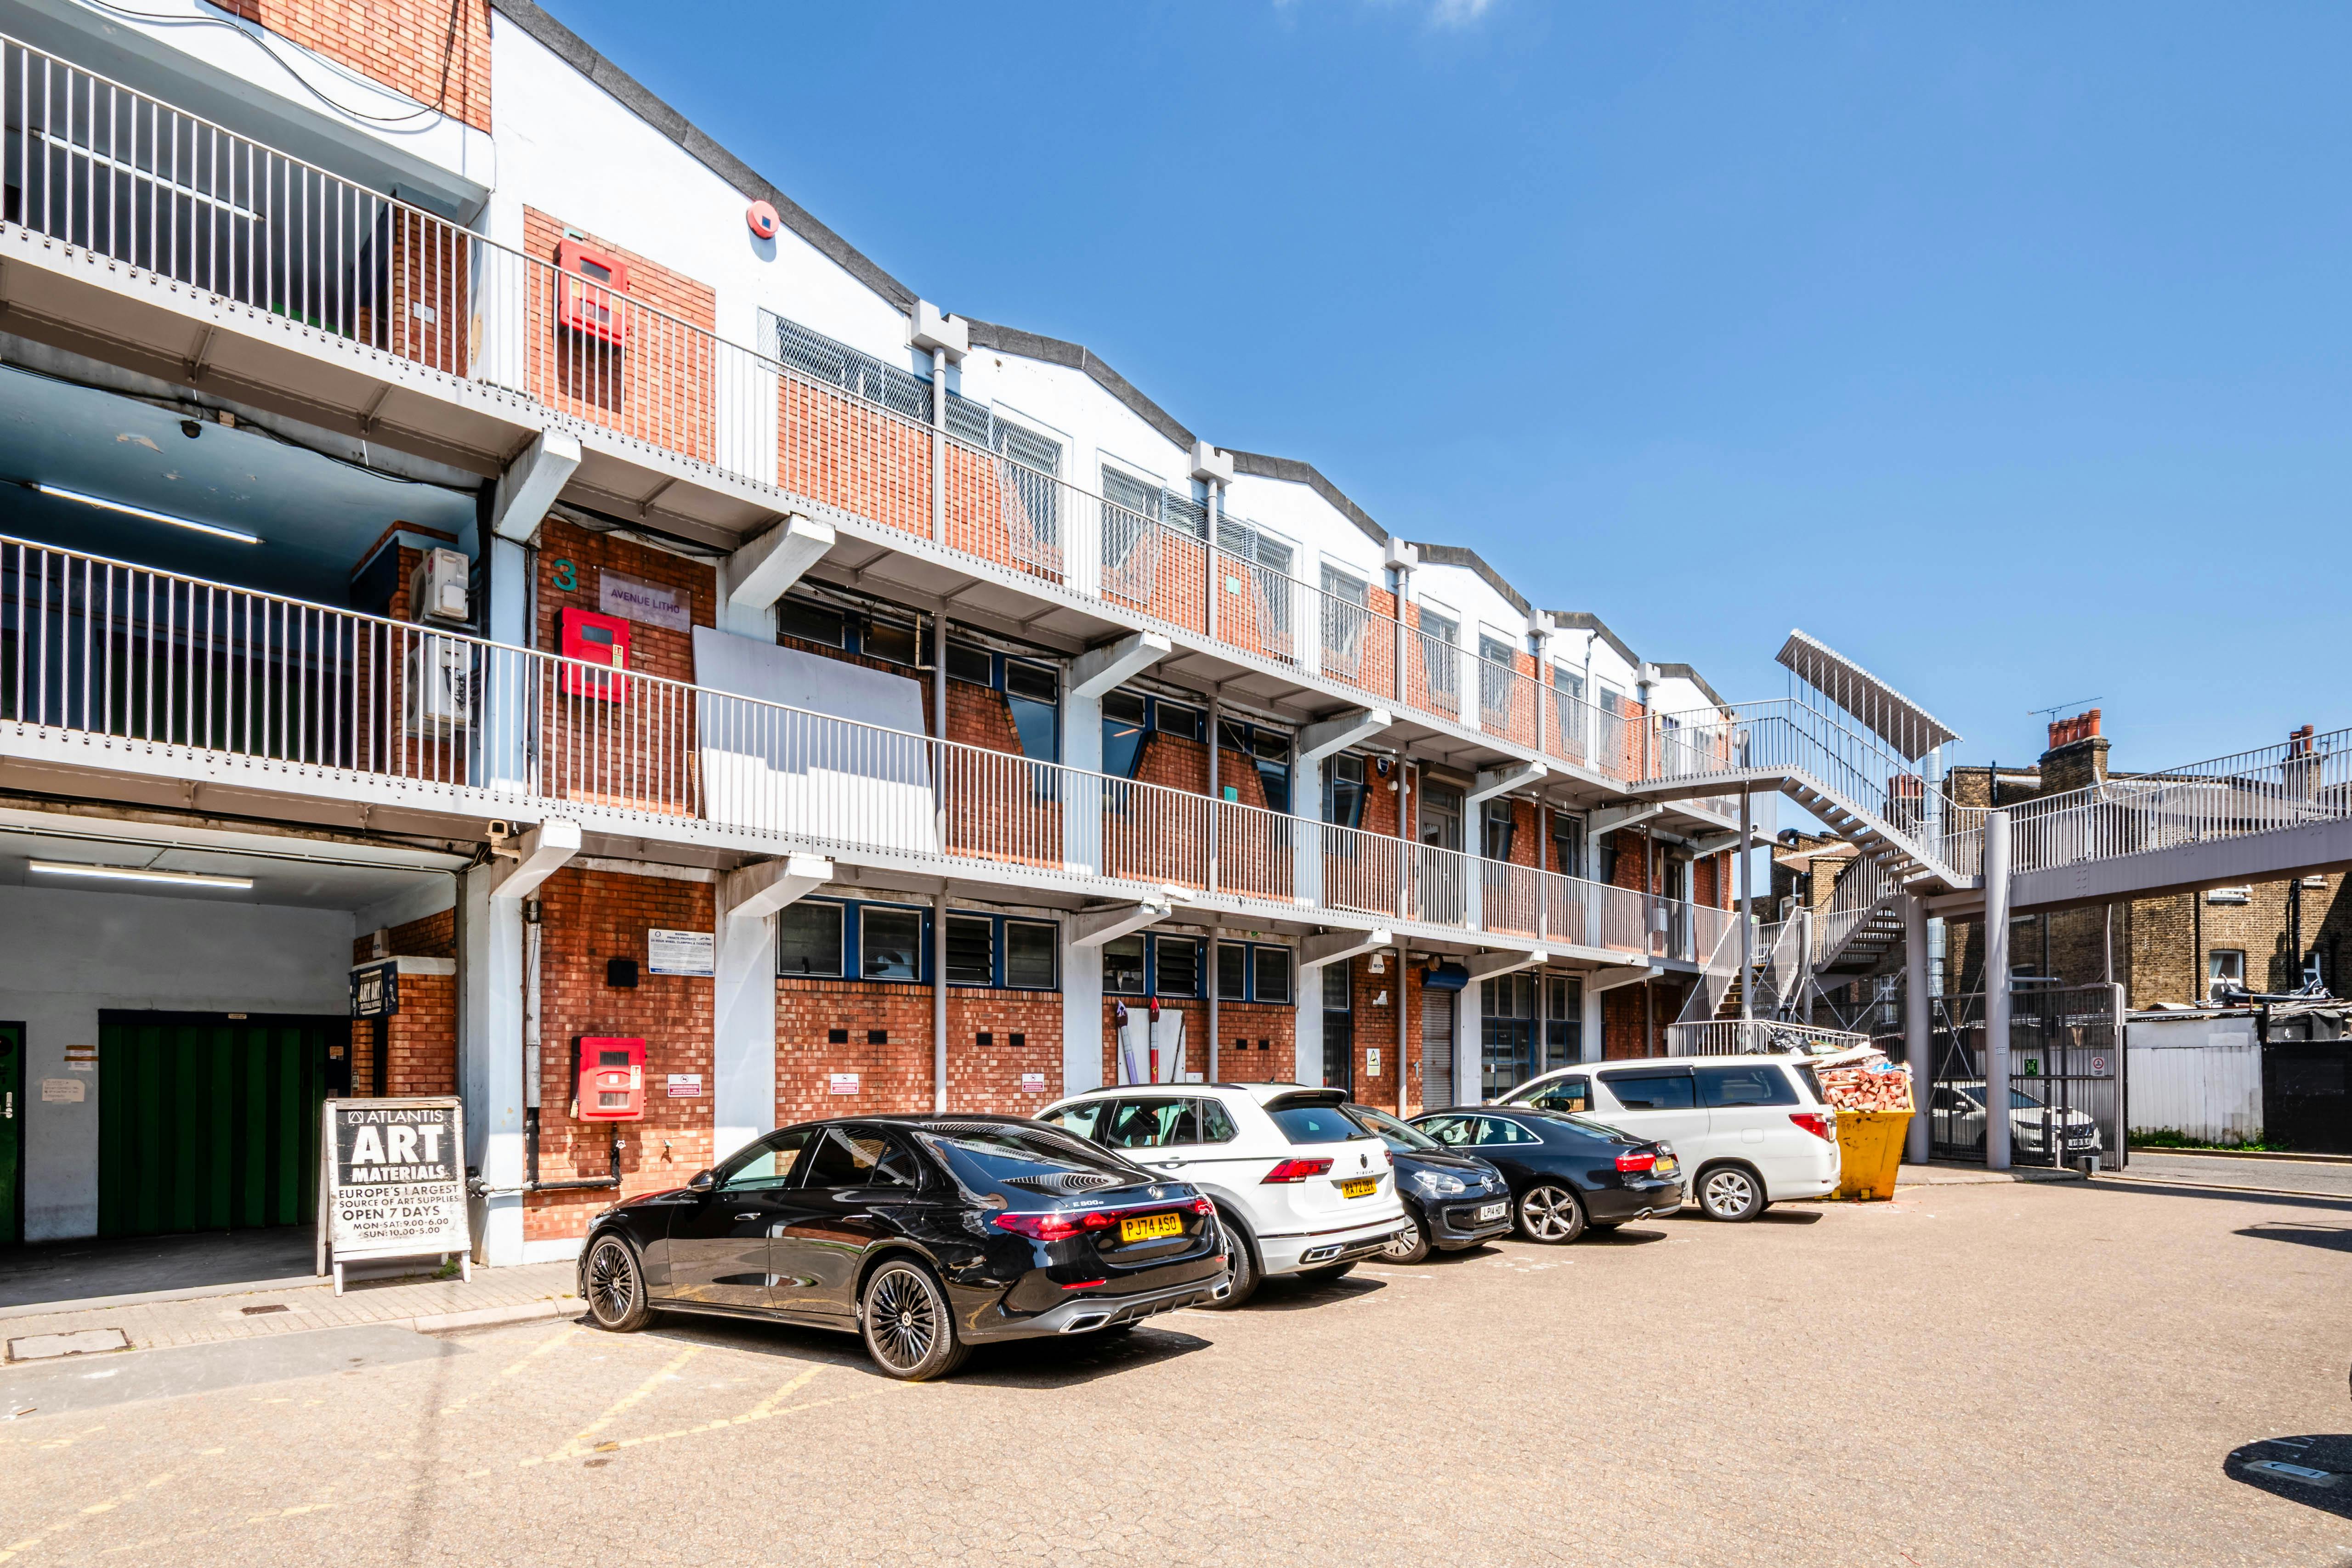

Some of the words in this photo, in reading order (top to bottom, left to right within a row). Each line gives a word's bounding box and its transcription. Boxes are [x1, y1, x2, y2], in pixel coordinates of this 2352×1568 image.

[553, 559, 577, 591] 3
[611, 589, 650, 606] AVENUE
[653, 600, 680, 614] LITHO
[360, 983, 370, 1002] ART
[371, 980, 380, 1001] ART
[1413, 1061, 1419, 1078] 1
[367, 1109, 444, 1123] ATLANTIS
[351, 1124, 444, 1165] ART
[352, 1165, 445, 1183] MATERIALS
[339, 1186, 400, 1198] EUROPE'S
[404, 1184, 459, 1195] LARGEST
[1345, 1182, 1363, 1194] RA72
[340, 1199, 378, 1208] SOURCE
[417, 1195, 459, 1204] SUPPLIES
[342, 1209, 384, 1220] OPEN
[390, 1208, 397, 1217] 7
[402, 1206, 440, 1217] DAYS
[1126, 1220, 1155, 1237] PJ74
